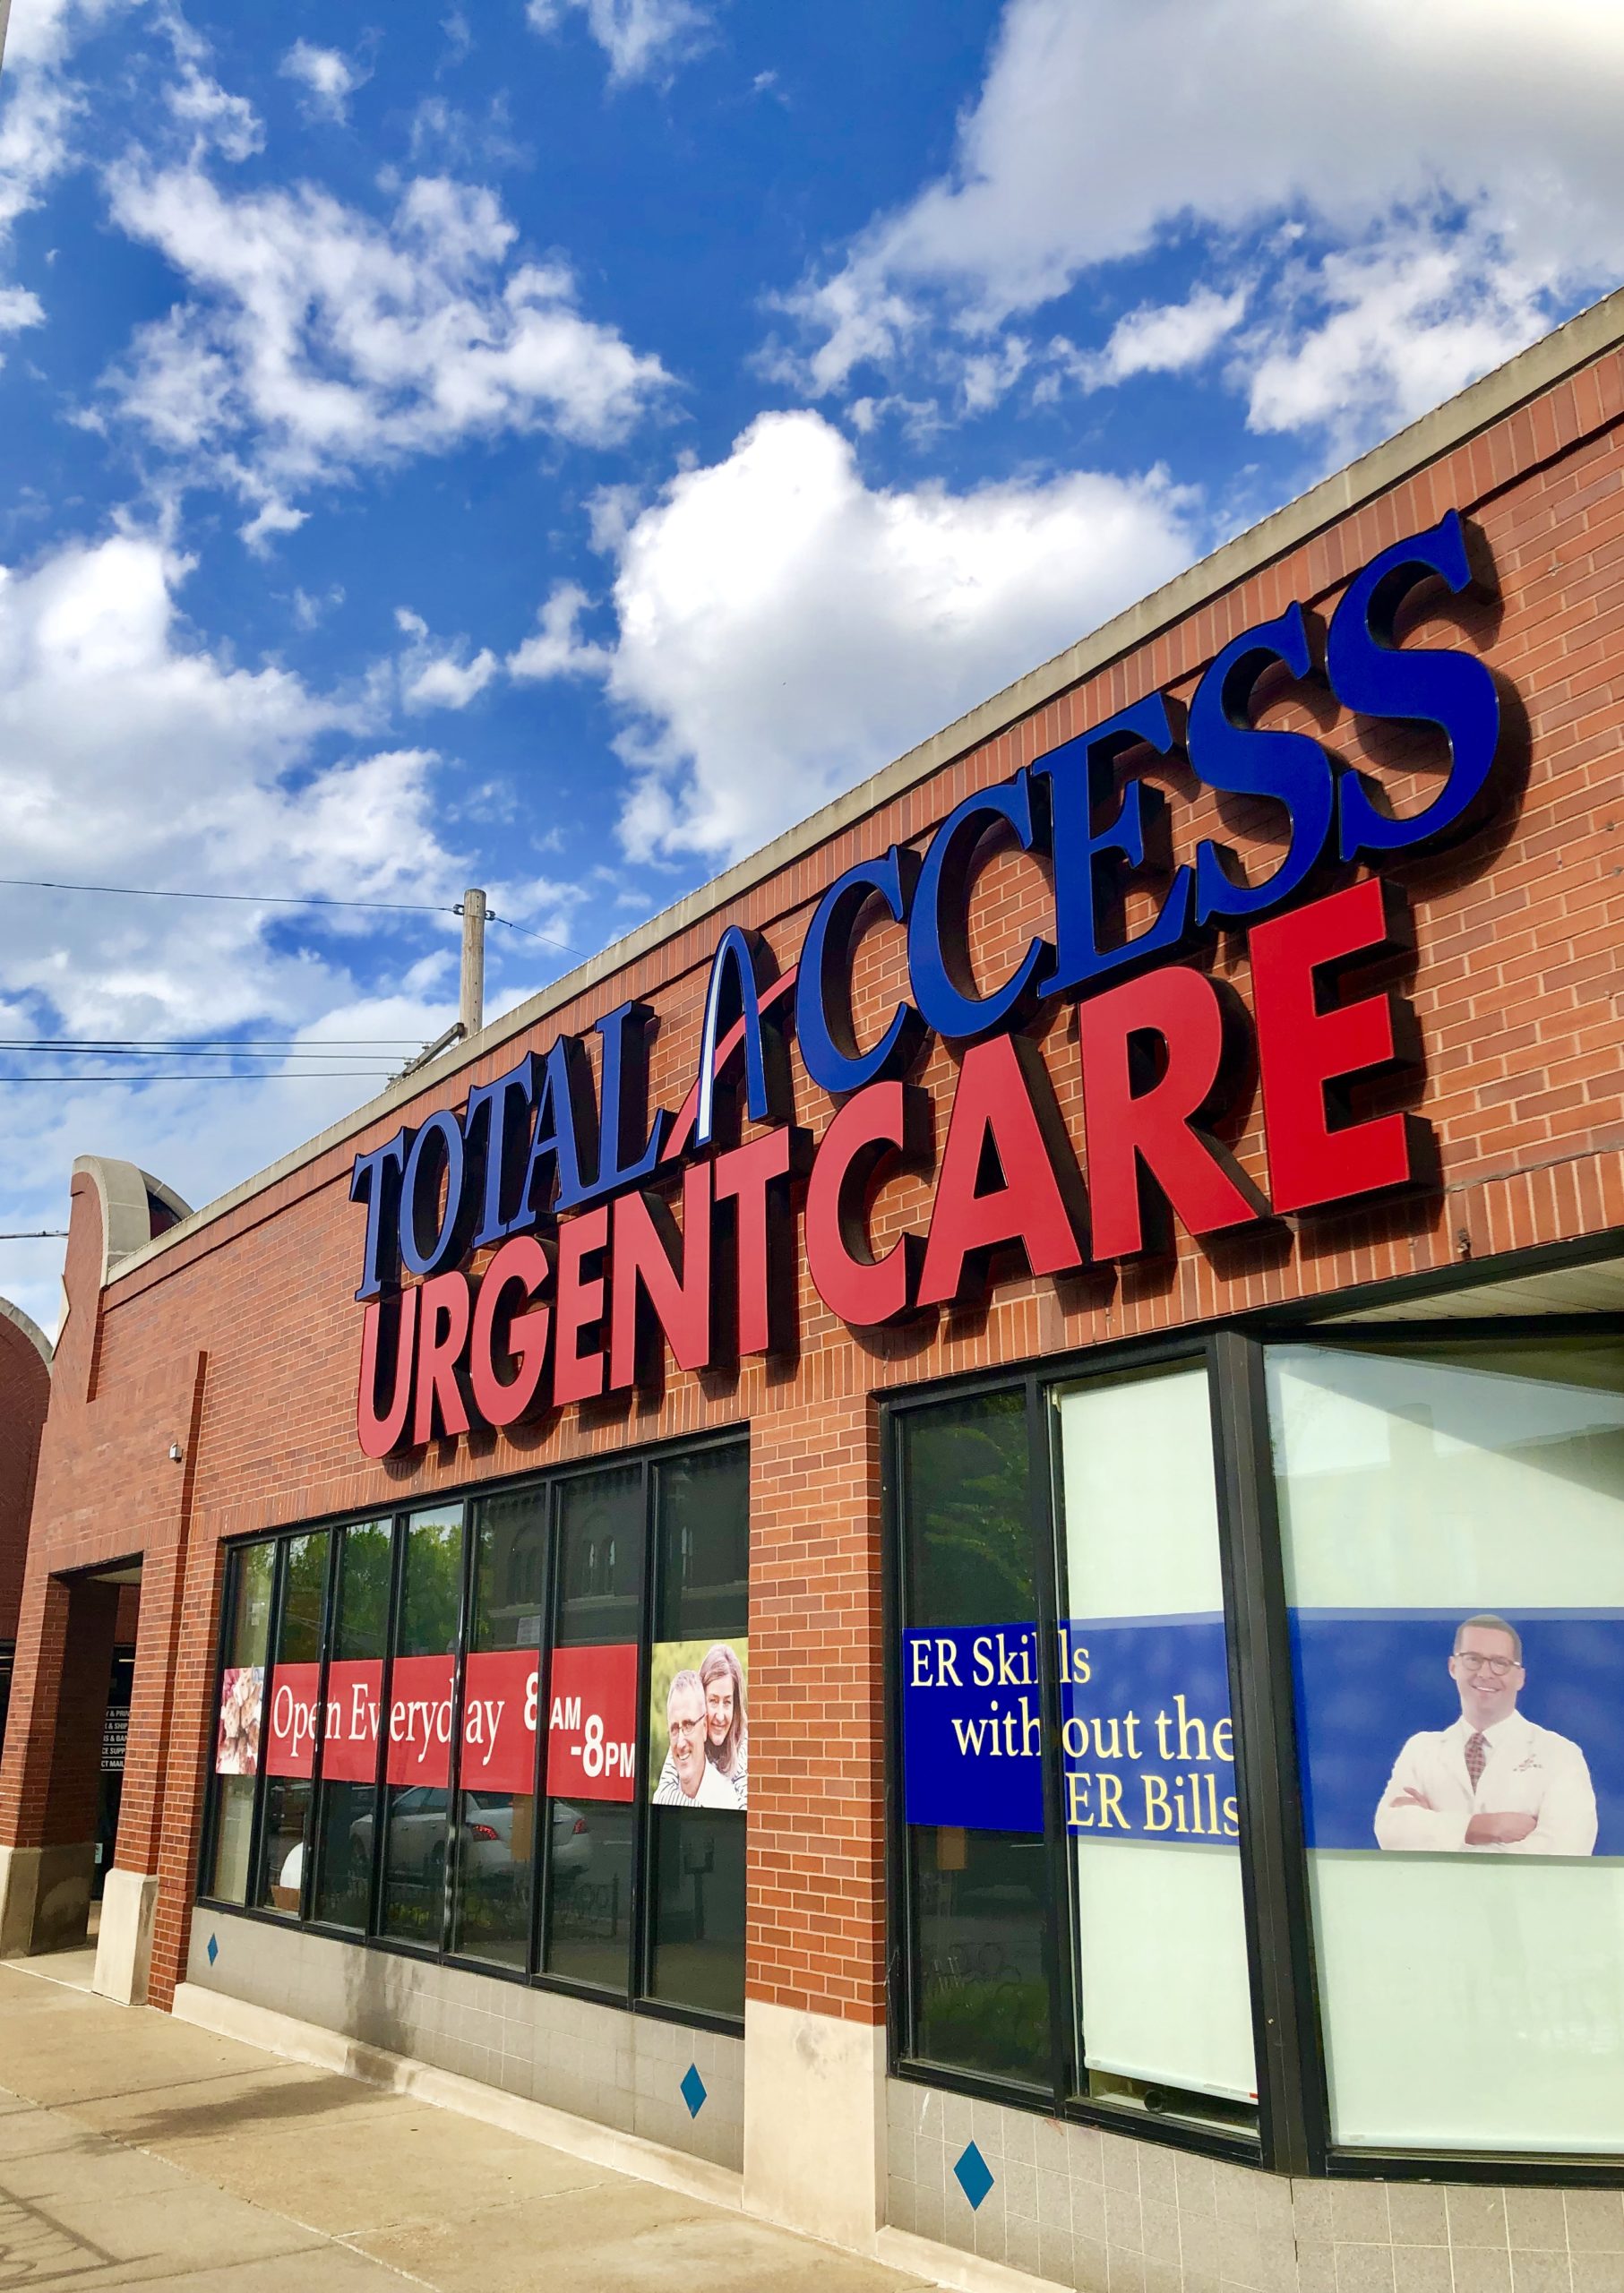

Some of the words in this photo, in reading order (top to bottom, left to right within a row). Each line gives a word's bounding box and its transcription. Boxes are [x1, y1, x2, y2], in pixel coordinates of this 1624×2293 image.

[349, 1000, 665, 1302] TOTAL
[665, 508, 1501, 1148] ACCESS
[357, 1125, 790, 1459] URGENT
[805, 878, 1411, 1326] CARE
[910, 1638, 963, 1687] ER
[272, 1684, 341, 1757] Open
[348, 1677, 505, 1766] Everyday
[951, 1696, 1143, 1760] without
[1155, 1695, 1234, 1762] the
[1065, 1772, 1131, 1830] ER
[1140, 1773, 1240, 1837] Bills
